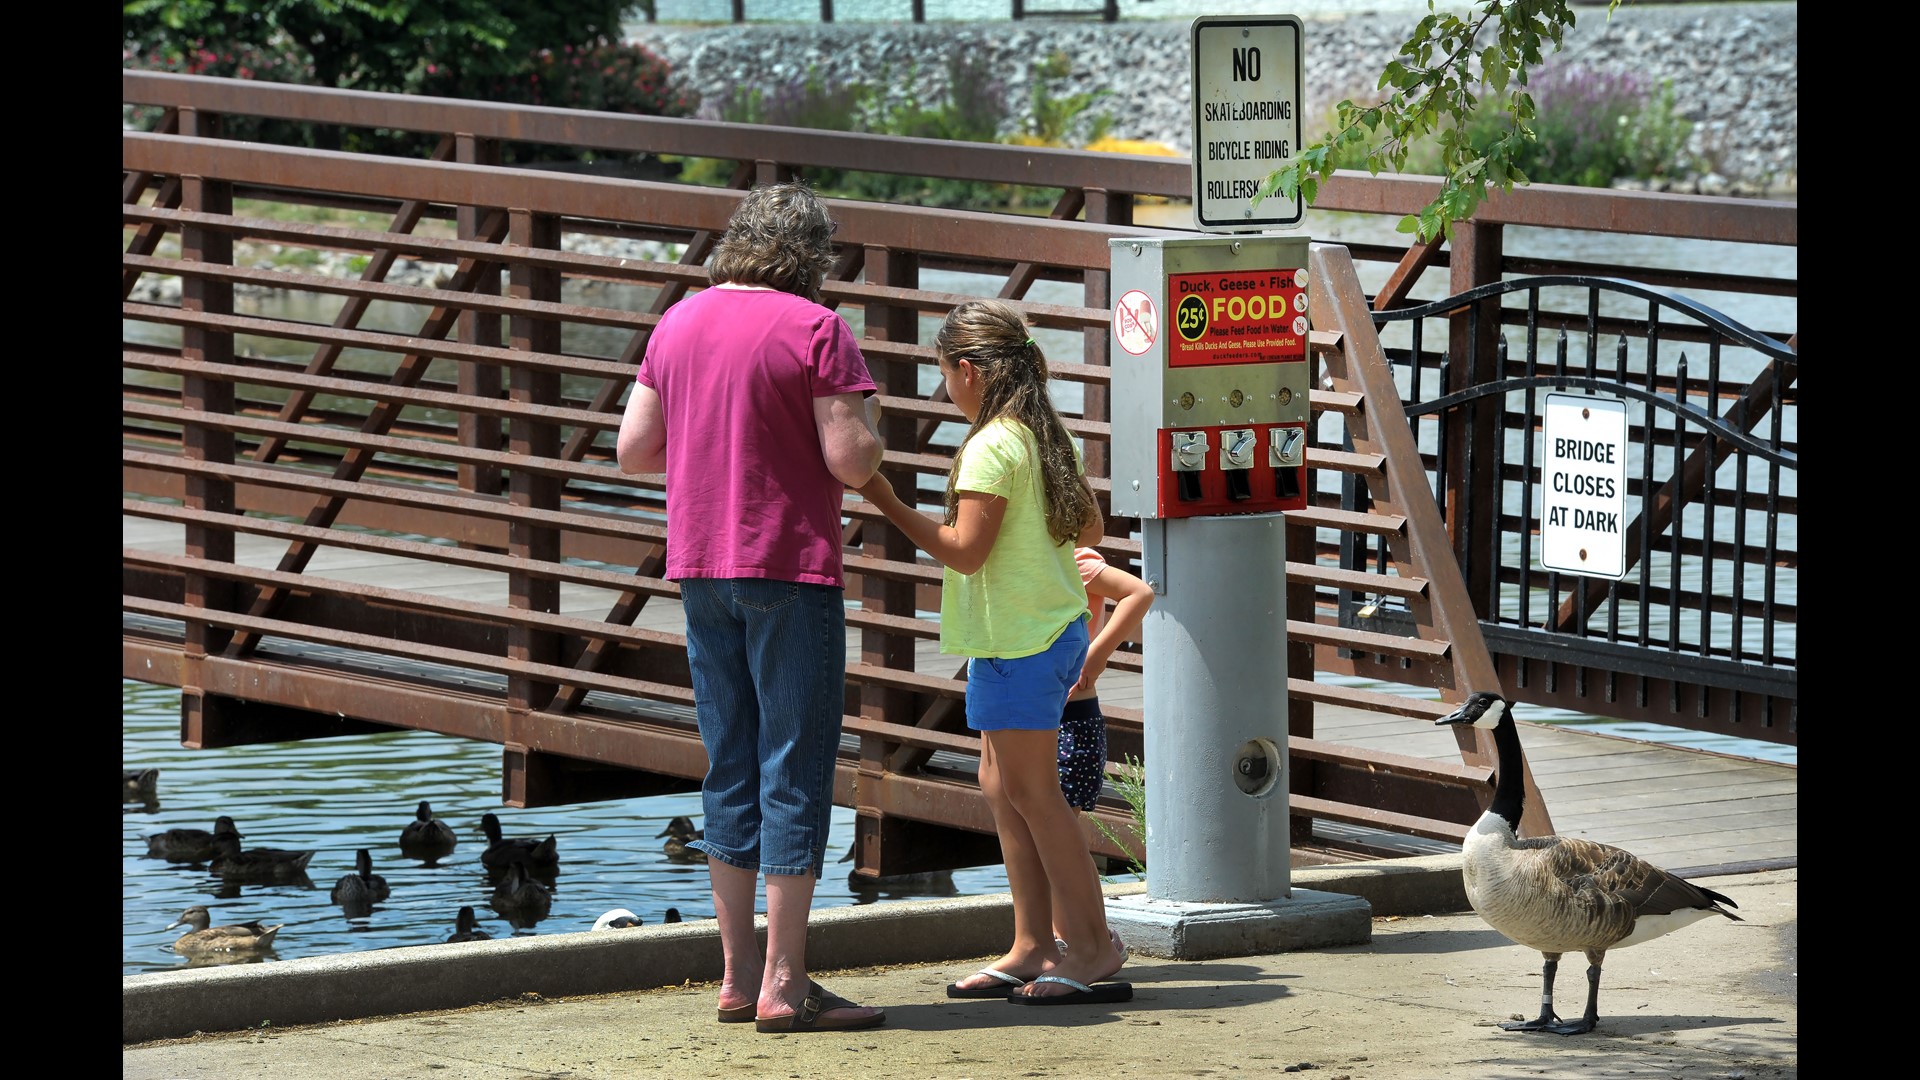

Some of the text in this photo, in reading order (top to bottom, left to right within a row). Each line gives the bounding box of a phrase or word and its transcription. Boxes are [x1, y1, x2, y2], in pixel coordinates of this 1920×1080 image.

[1232, 47, 1261, 82] NO
[1205, 101, 1291, 121] SKATEBOARDING
[1208, 140, 1289, 161] BICYCLE RIDING
[1207, 180, 1289, 200] ROLLERSK
[1180, 280, 1214, 293] Duck,
[1219, 278, 1256, 291] Geese
[1269, 276, 1294, 288] Fish
[1180, 307, 1204, 329] 25¢
[1213, 295, 1287, 321] FOOD
[1210, 327, 1229, 336] Please
[1231, 326, 1244, 336] Feed
[1246, 325, 1261, 335] Food
[1195, 342, 1204, 350] Kills
[1205, 342, 1218, 350] Ducks
[1219, 341, 1228, 349] And
[1243, 340, 1256, 348] Please
[1257, 339, 1265, 347] Use
[1266, 338, 1284, 347] Provided
[1285, 337, 1296, 346] Food.
[1555, 437, 1615, 464] BRIDGE
[1553, 471, 1615, 498] CLOSES
[1549, 505, 1618, 534] AT DARK
